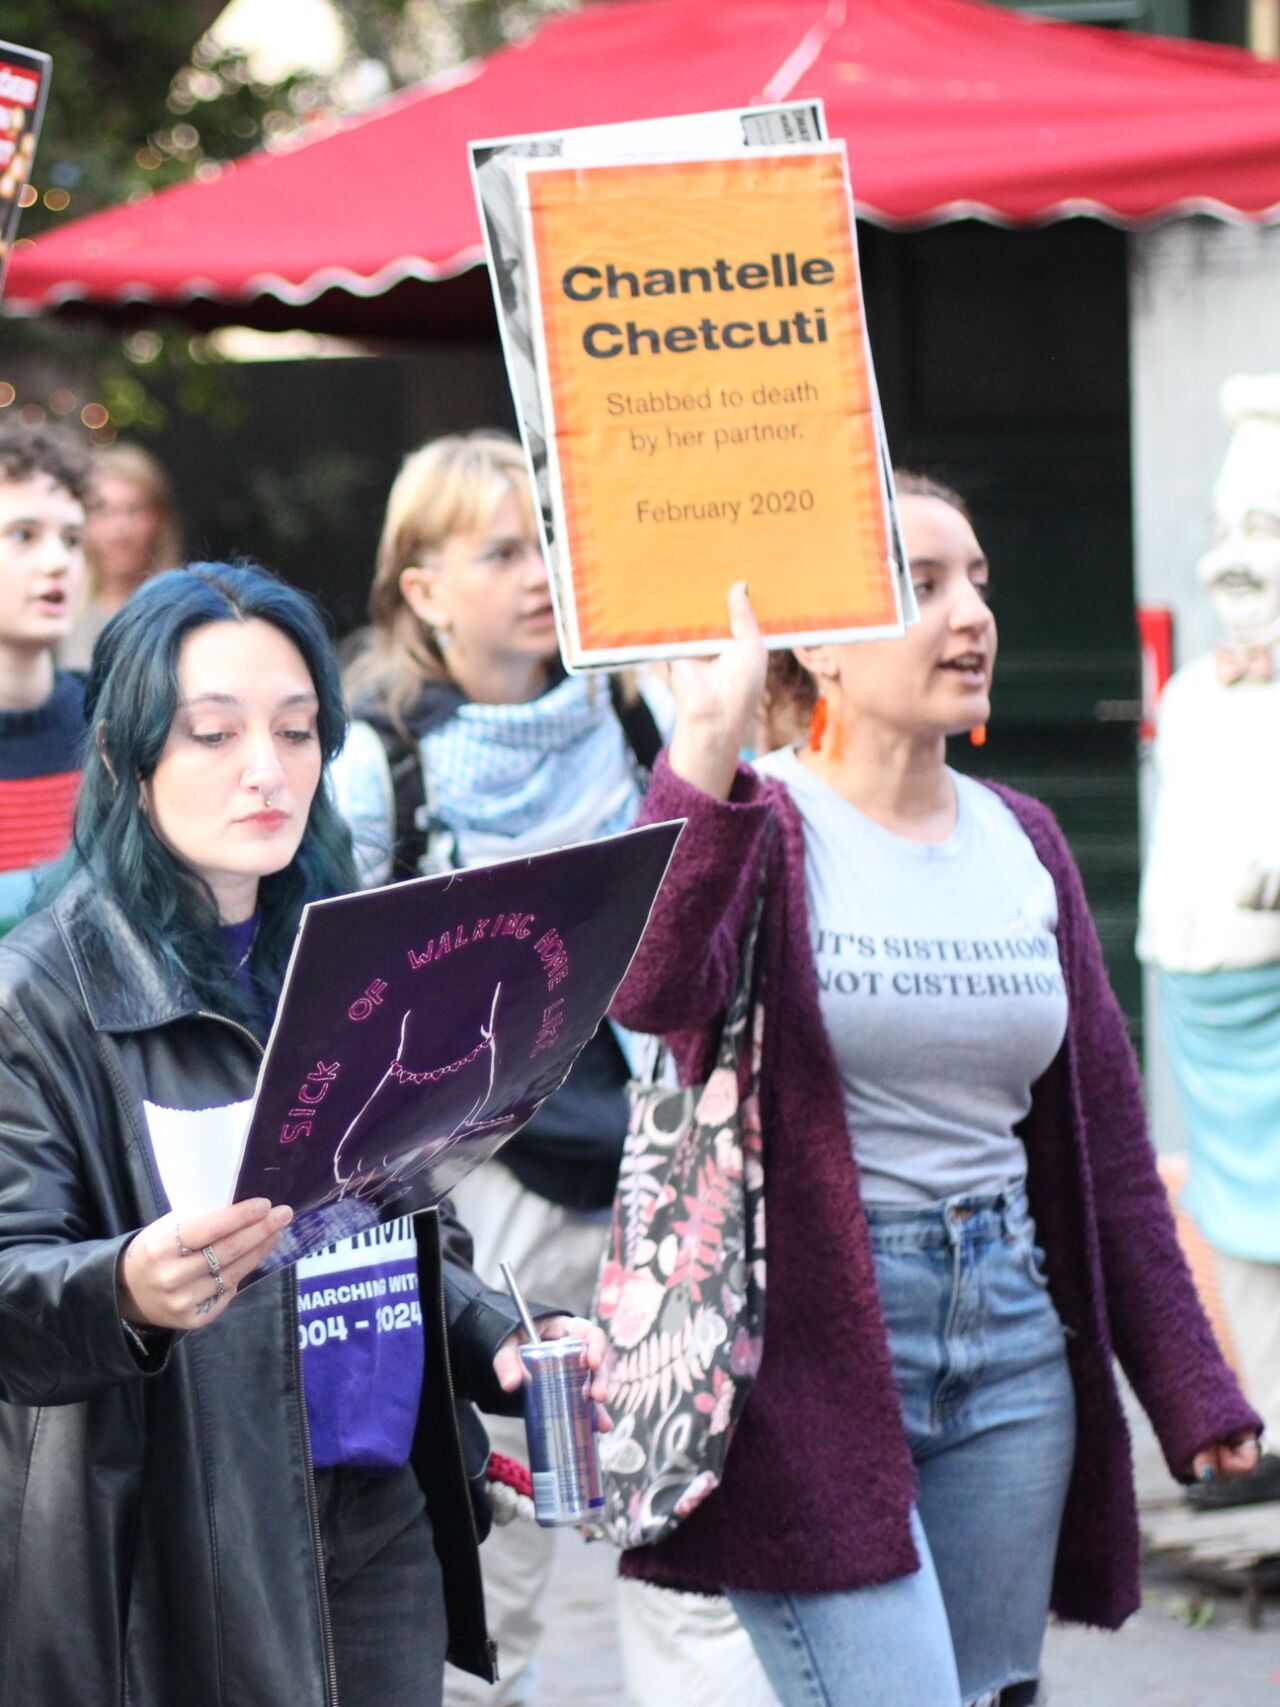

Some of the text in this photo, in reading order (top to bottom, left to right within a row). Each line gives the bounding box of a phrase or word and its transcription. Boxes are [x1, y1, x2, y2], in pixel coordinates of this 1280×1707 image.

[562, 252, 835, 302] Chantelle
[582, 308, 828, 359] Chetcuti
[606, 379, 819, 416] Stabbed to death
[630, 421, 804, 456] by her partner.
[636, 489, 815, 524] February 2020
[818, 929, 876, 958] IT'S
[813, 967, 884, 996] NOT
[280, 1061, 341, 1144] SICK
[348, 978, 388, 1020] OF
[407, 912, 535, 969] WALKING
[388, 1272, 418, 1293] WIT
